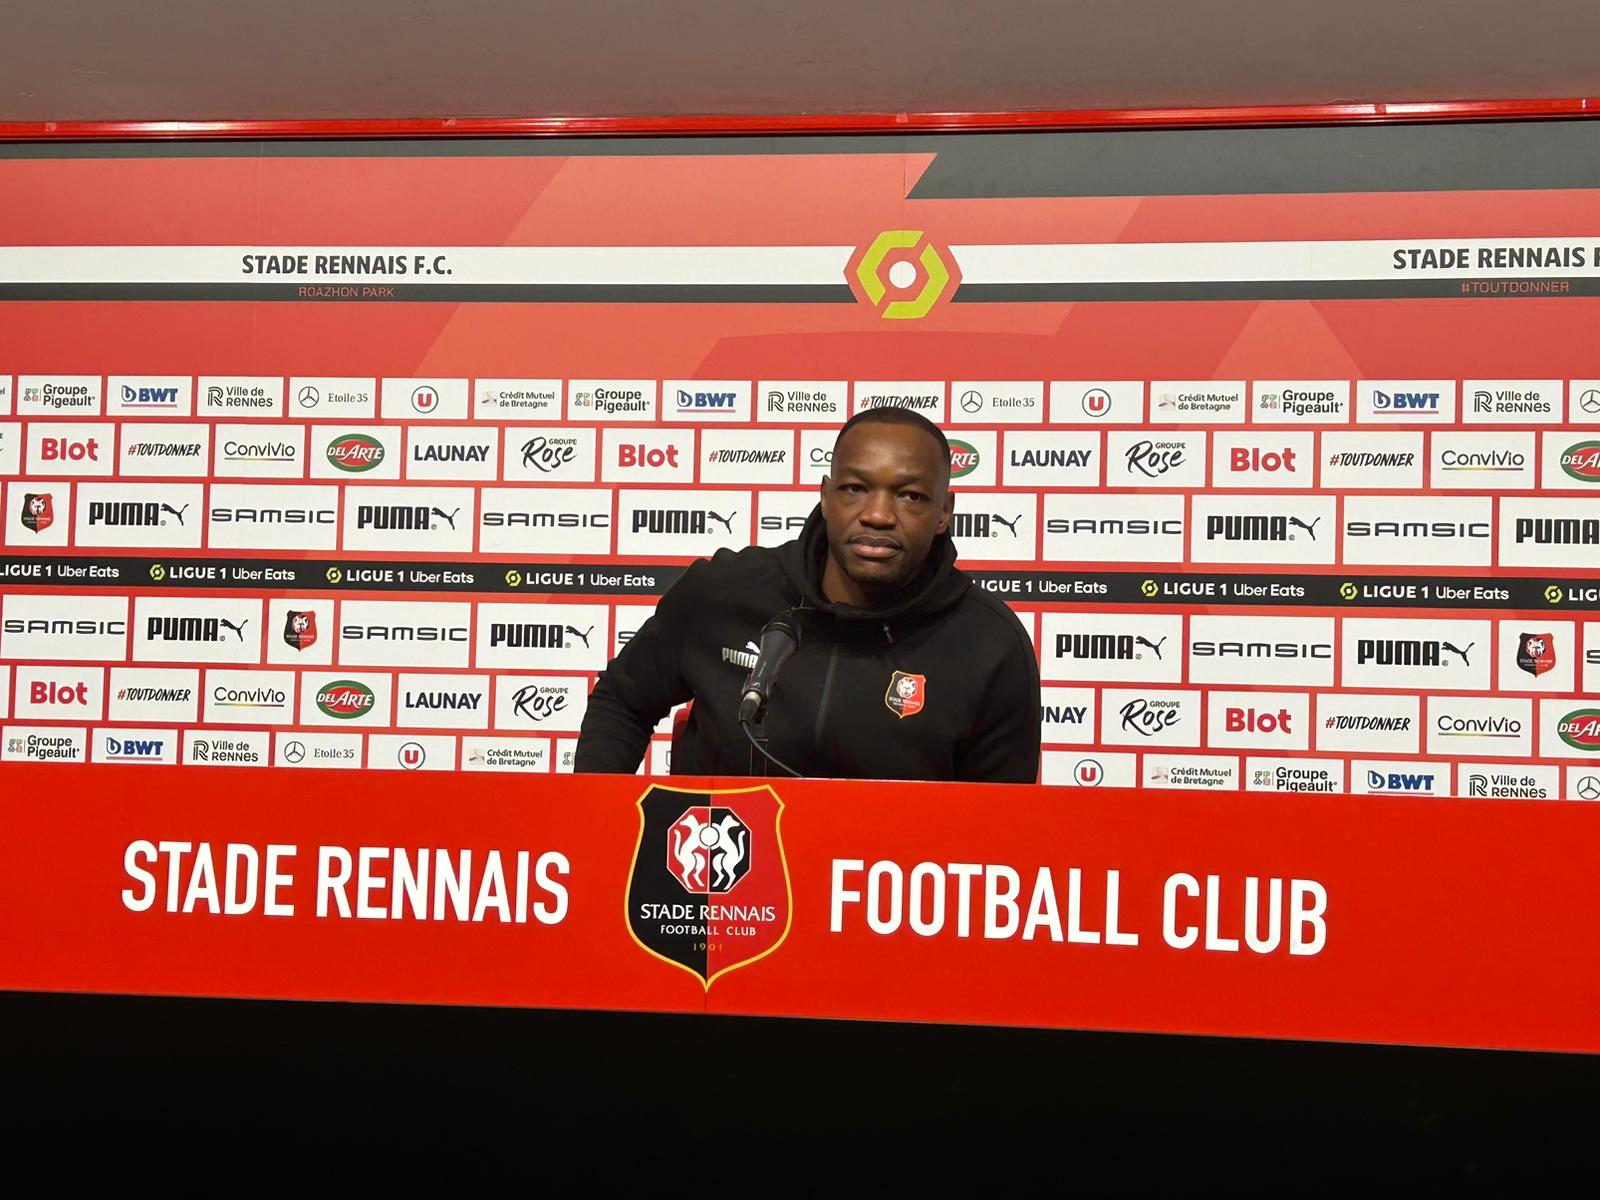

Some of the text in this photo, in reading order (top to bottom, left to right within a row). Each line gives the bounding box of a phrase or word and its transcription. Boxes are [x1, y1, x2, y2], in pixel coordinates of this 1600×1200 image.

[243, 255, 452, 274] STADE RENNAIS F.C.
[1394, 249, 1469, 269] STADE
[1478, 247, 1585, 268] RENNAIS
[299, 287, 394, 296] ROAZHON PARK
[1462, 281, 1569, 293] #TOUTDONNER
[43, 384, 87, 400] Groupe
[139, 388, 178, 402] BWT
[226, 387, 263, 396] Ville de
[328, 393, 368, 402] Etoile 35
[595, 388, 641, 405] Groupe
[788, 391, 826, 401] Ville de
[1283, 390, 1334, 403] Groupe
[1496, 391, 1539, 401] Ville de
[418, 393, 432, 407] U
[511, 400, 547, 409] Bretagne
[695, 393, 736, 407] BWT
[861, 396, 938, 409] #TOUTDONNER
[993, 398, 1034, 407] Etoile 35
[1089, 396, 1104, 411] U
[1394, 393, 1439, 408] BWT
[1191, 403, 1231, 412] Bretagne
[42, 438, 98, 461] Blot
[128, 443, 201, 456] #TOUTDONNER
[415, 445, 489, 461] LAUNAY
[521, 437, 576, 472] Rose
[619, 444, 678, 468] Blot
[709, 450, 786, 463] #TOUTDONNER
[950, 452, 978, 468] RTE
[1011, 450, 1092, 467] LAUNAY
[1125, 441, 1185, 477] Rose
[1231, 448, 1295, 472] Blot
[1330, 453, 1414, 466] #TOUTDONNER
[89, 502, 159, 526] PUMA
[212, 509, 334, 523] SAMSIC
[358, 506, 429, 530] PUMA
[483, 513, 608, 527] SAMSIC
[632, 510, 705, 534] PUMA
[951, 514, 990, 538] MA
[1047, 520, 1181, 534] SAMSIC
[1207, 516, 1286, 540] PUMA
[1347, 522, 1489, 537] SAMSIC
[1516, 519, 1599, 544] PUMA
[46, 565, 51, 576] 1
[58, 565, 87, 577] Uber
[90, 566, 119, 577] Eats
[170, 567, 295, 580] LIGUE 1 Uber Eats
[347, 570, 474, 583] LIGUE 1 Uber Eats
[527, 573, 655, 586] LIGUE 1 Uber Eats
[972, 580, 1107, 593] IGUE 1 Uber Eats
[1164, 583, 1304, 596] LIGUE 1 Uber Eats
[1364, 586, 1509, 600] LIGUE 1 Uber Eats
[1569, 589, 1600, 601] LIG
[4, 620, 125, 635] SAMSIC
[148, 617, 218, 641] PUMA
[343, 626, 467, 641] SAMSIC
[491, 624, 563, 648] PUMA
[1056, 634, 1133, 659] PUMA
[1193, 642, 1331, 658] SAMSIC
[1358, 640, 1439, 666] PUMA
[722, 647, 758, 668] PUMA
[30, 681, 87, 705] Blot
[118, 688, 191, 701] #TOUTDONNER
[406, 692, 482, 709] LAUNAY
[512, 685, 568, 721] Rose
[1120, 699, 1180, 736] Rose
[1226, 708, 1291, 734] Blot
[1326, 716, 1410, 730] #TOUTDONNER
[27, 734, 72, 748] Groupe
[124, 741, 163, 755] BWT
[212, 741, 249, 751] Ville de
[314, 749, 354, 758] Etoile 35
[405, 750, 418, 764] U
[487, 749, 542, 758] Crédit Mutuel
[487, 757, 535, 767] de Bretagne
[1081, 767, 1096, 782] U
[1200, 768, 1231, 776] Mutuel
[1276, 767, 1328, 782] Groupe
[1171, 776, 1224, 786] de Bretagne
[1388, 774, 1434, 790] BWT
[1491, 775, 1535, 786] Ville de
[122, 840, 569, 924] STADE RENNAIS
[641, 904, 775, 921] STADE RENNAIS
[831, 859, 1327, 955] FOOTBALL CLUB
[661, 925, 756, 936] FOOTBALL CLUB
[693, 943, 723, 951] 1901
